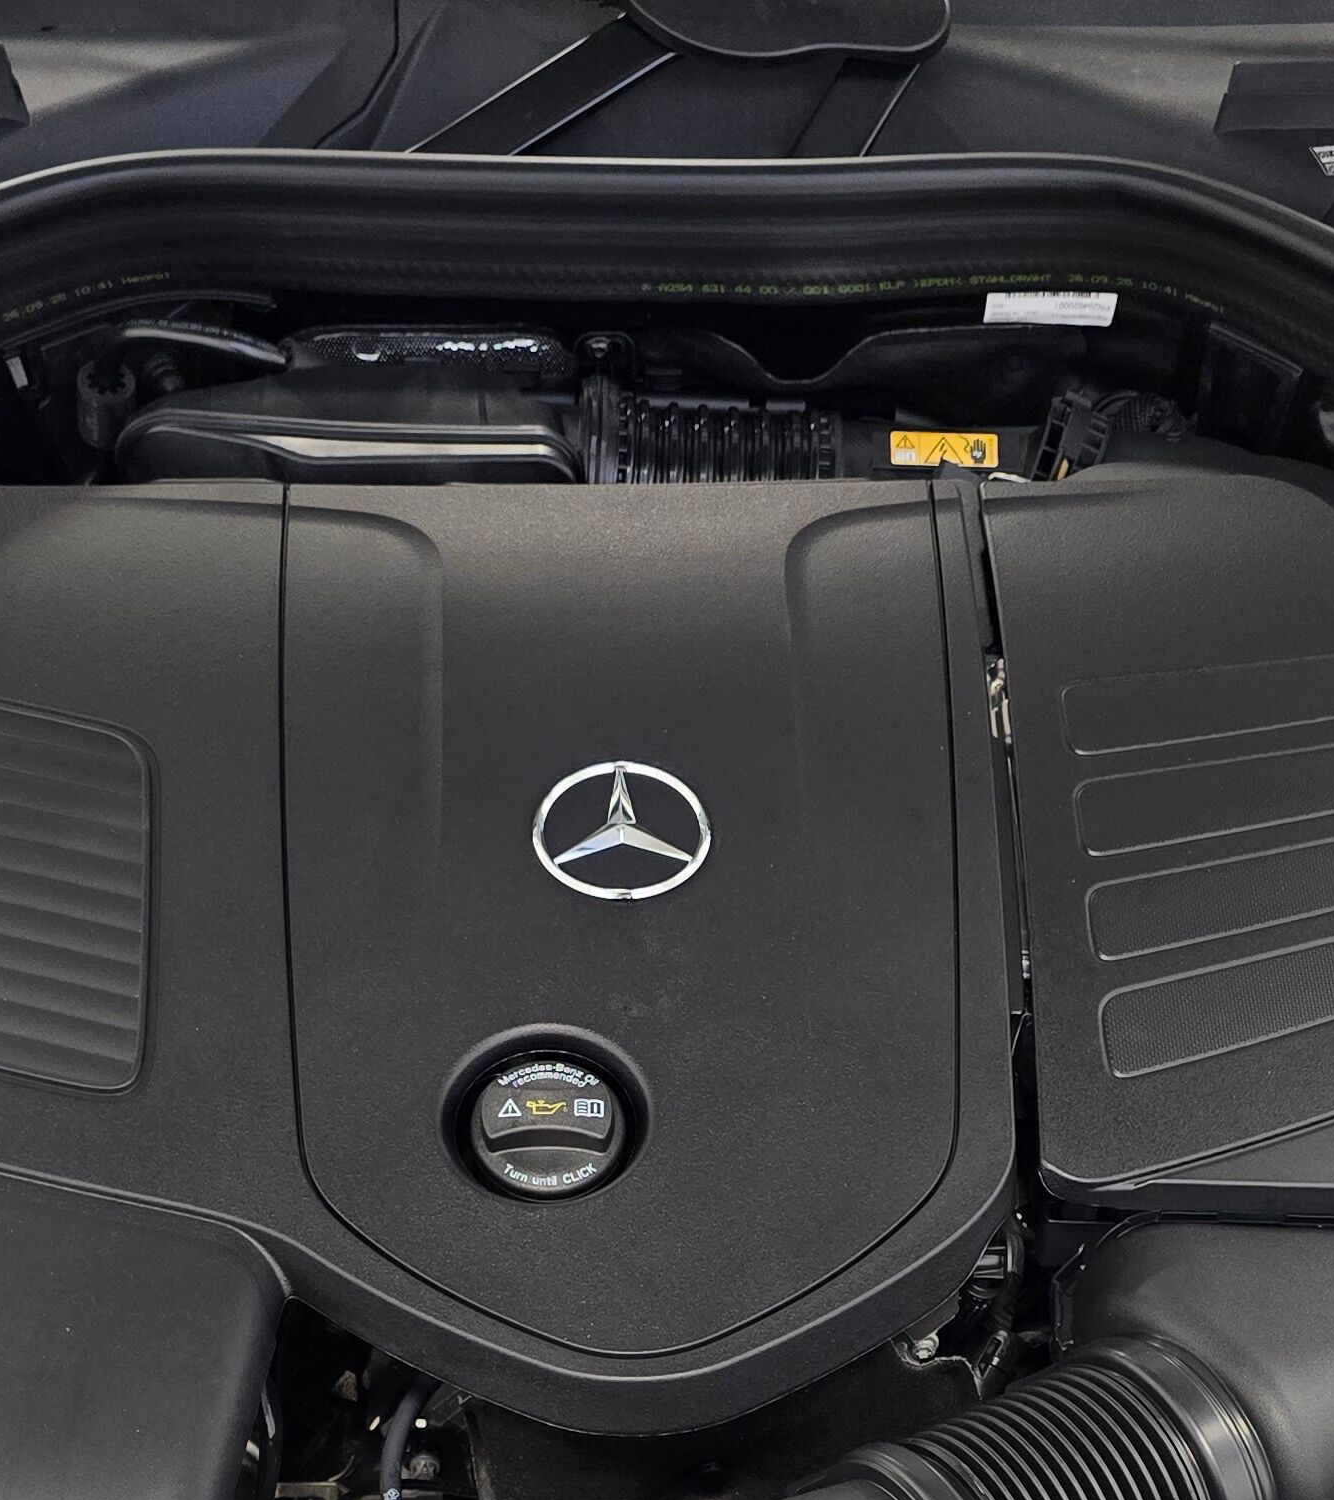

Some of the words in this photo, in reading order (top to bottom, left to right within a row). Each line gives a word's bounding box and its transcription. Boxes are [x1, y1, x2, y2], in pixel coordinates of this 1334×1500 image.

[497, 1063, 585, 1088] Mercedes-Benz
[513, 1072, 588, 1089] recommended
[503, 1164, 529, 1183] Turn
[532, 1175, 558, 1187] until
[562, 1163, 598, 1185] CLICK
